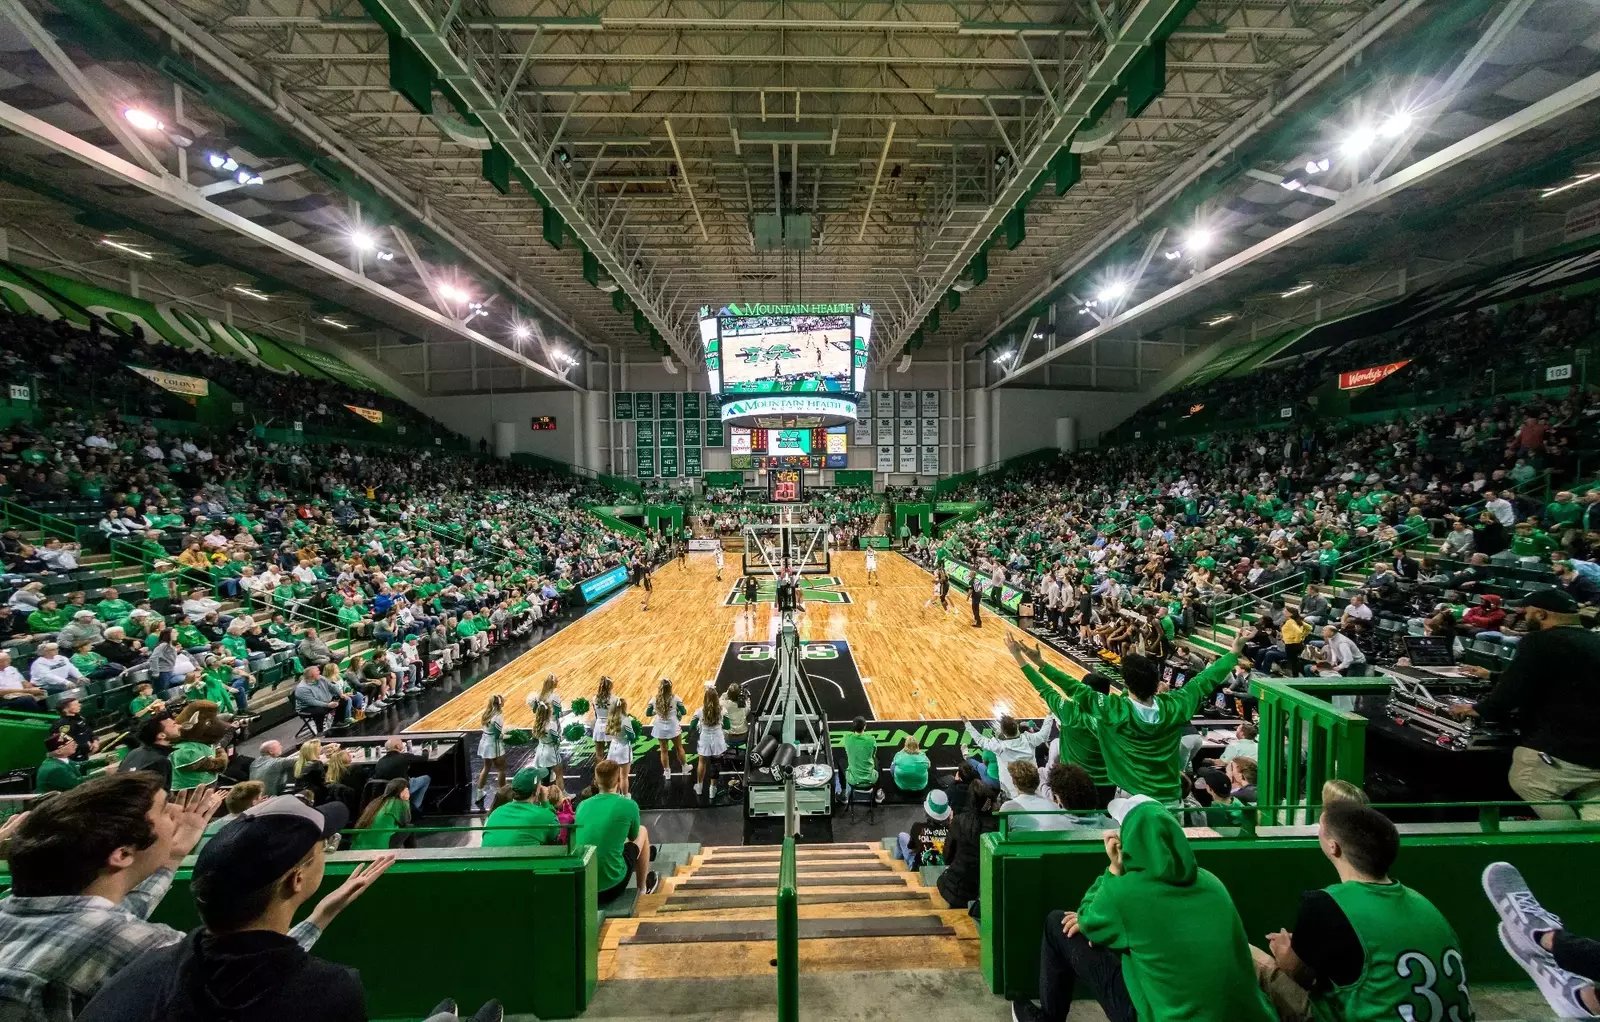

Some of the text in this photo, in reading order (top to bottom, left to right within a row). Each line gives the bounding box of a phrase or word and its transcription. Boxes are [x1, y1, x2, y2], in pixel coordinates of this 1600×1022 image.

[811, 303, 855, 314] HEALTH
[1349, 367, 1382, 386] Wendy's
[1550, 367, 1568, 378] 103
[163, 378, 197, 389] COLONY
[11, 388, 29, 398] 110
[807, 399, 841, 409] HEALTH
[777, 471, 799, 482] 4:26
[1396, 948, 1474, 1022] 33
